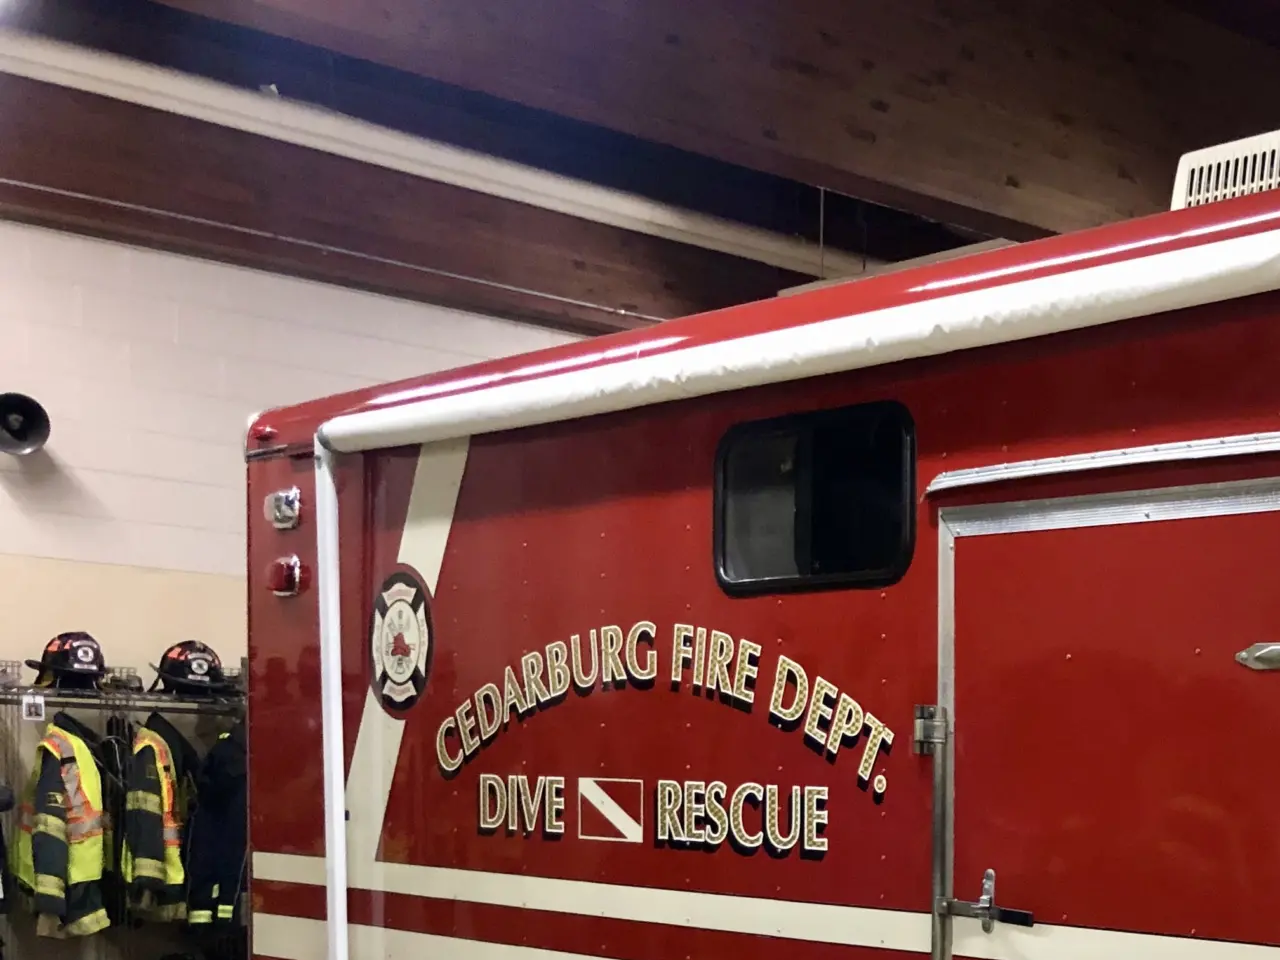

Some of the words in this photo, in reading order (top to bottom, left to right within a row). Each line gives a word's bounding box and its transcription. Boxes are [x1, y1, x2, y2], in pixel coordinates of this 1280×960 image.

[435, 620, 657, 773] CEDARBURG
[671, 623, 763, 705] FIRE
[769, 655, 894, 794] DEPT.
[480, 774, 565, 833] DIVE
[657, 780, 829, 852] RESCUE
